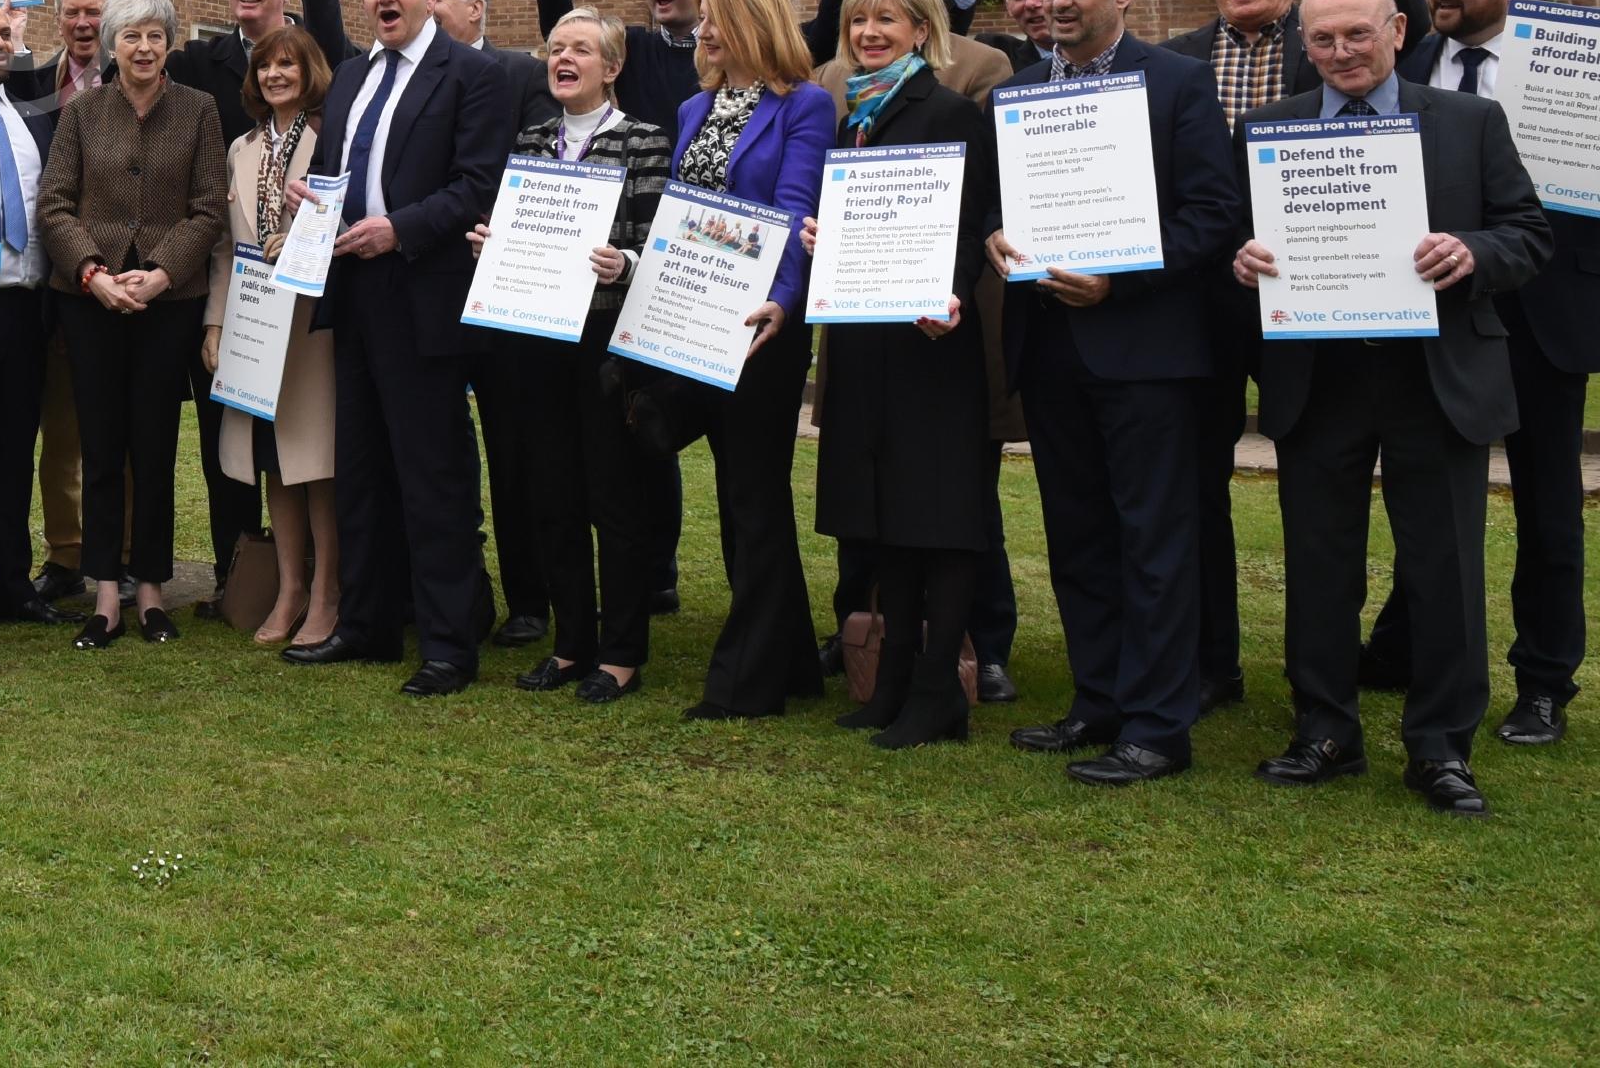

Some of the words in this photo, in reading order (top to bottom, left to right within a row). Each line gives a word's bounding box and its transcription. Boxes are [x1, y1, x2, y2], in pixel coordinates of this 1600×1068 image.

[1535, 28, 1597, 50] Building
[1530, 61, 1550, 73] for
[1554, 68, 1578, 78] our
[1023, 105, 1072, 121] Protect
[1076, 103, 1098, 115] the
[1024, 119, 1096, 136] vulnerable
[1251, 126, 1274, 135] OUR
[1276, 123, 1322, 134] PLEDGES
[1324, 122, 1345, 130] FOR
[1348, 120, 1368, 129] THE
[1370, 118, 1412, 127] FUTURE
[1280, 148, 1335, 161] Defend
[1339, 147, 1365, 158] the
[848, 170, 857, 180] A
[860, 167, 937, 180] sustainable,
[1281, 163, 1355, 182] greenbelt
[1360, 163, 1397, 175] from
[523, 178, 561, 193] Defend
[564, 182, 581, 195] the
[847, 180, 950, 194] environmentally
[1283, 181, 1371, 199] speculative
[519, 193, 569, 208] greenbelt
[573, 199, 598, 211] from
[845, 195, 893, 208] friendly
[897, 194, 932, 206] Royal
[1284, 198, 1386, 214] development
[515, 207, 576, 223] speculative
[843, 210, 897, 222] Borough
[511, 219, 582, 237] development
[1285, 224, 1316, 234] Support
[1318, 222, 1376, 232] neighbourhood
[1286, 235, 1319, 244] planning
[1322, 234, 1348, 243] groups
[668, 243, 699, 260] State
[701, 251, 714, 264] of
[716, 256, 735, 271] the
[1289, 254, 1310, 262] Resist
[1313, 253, 1349, 263] greenbelt
[1351, 252, 1380, 260] release
[244, 265, 268, 280] Enhance
[664, 259, 679, 270] art
[682, 265, 707, 279] new
[709, 271, 750, 291] leisure
[1290, 273, 1309, 281] Work
[1311, 271, 1369, 281] collaboratively
[1371, 271, 1385, 279] with
[241, 279, 259, 293] public
[260, 283, 276, 295] open
[659, 271, 707, 294] facilities
[1291, 283, 1314, 291] Parish
[1316, 283, 1349, 291] Councils
[239, 293, 260, 306] spaces
[1294, 311, 1326, 322] Vote
[1332, 308, 1431, 322] Conservative
